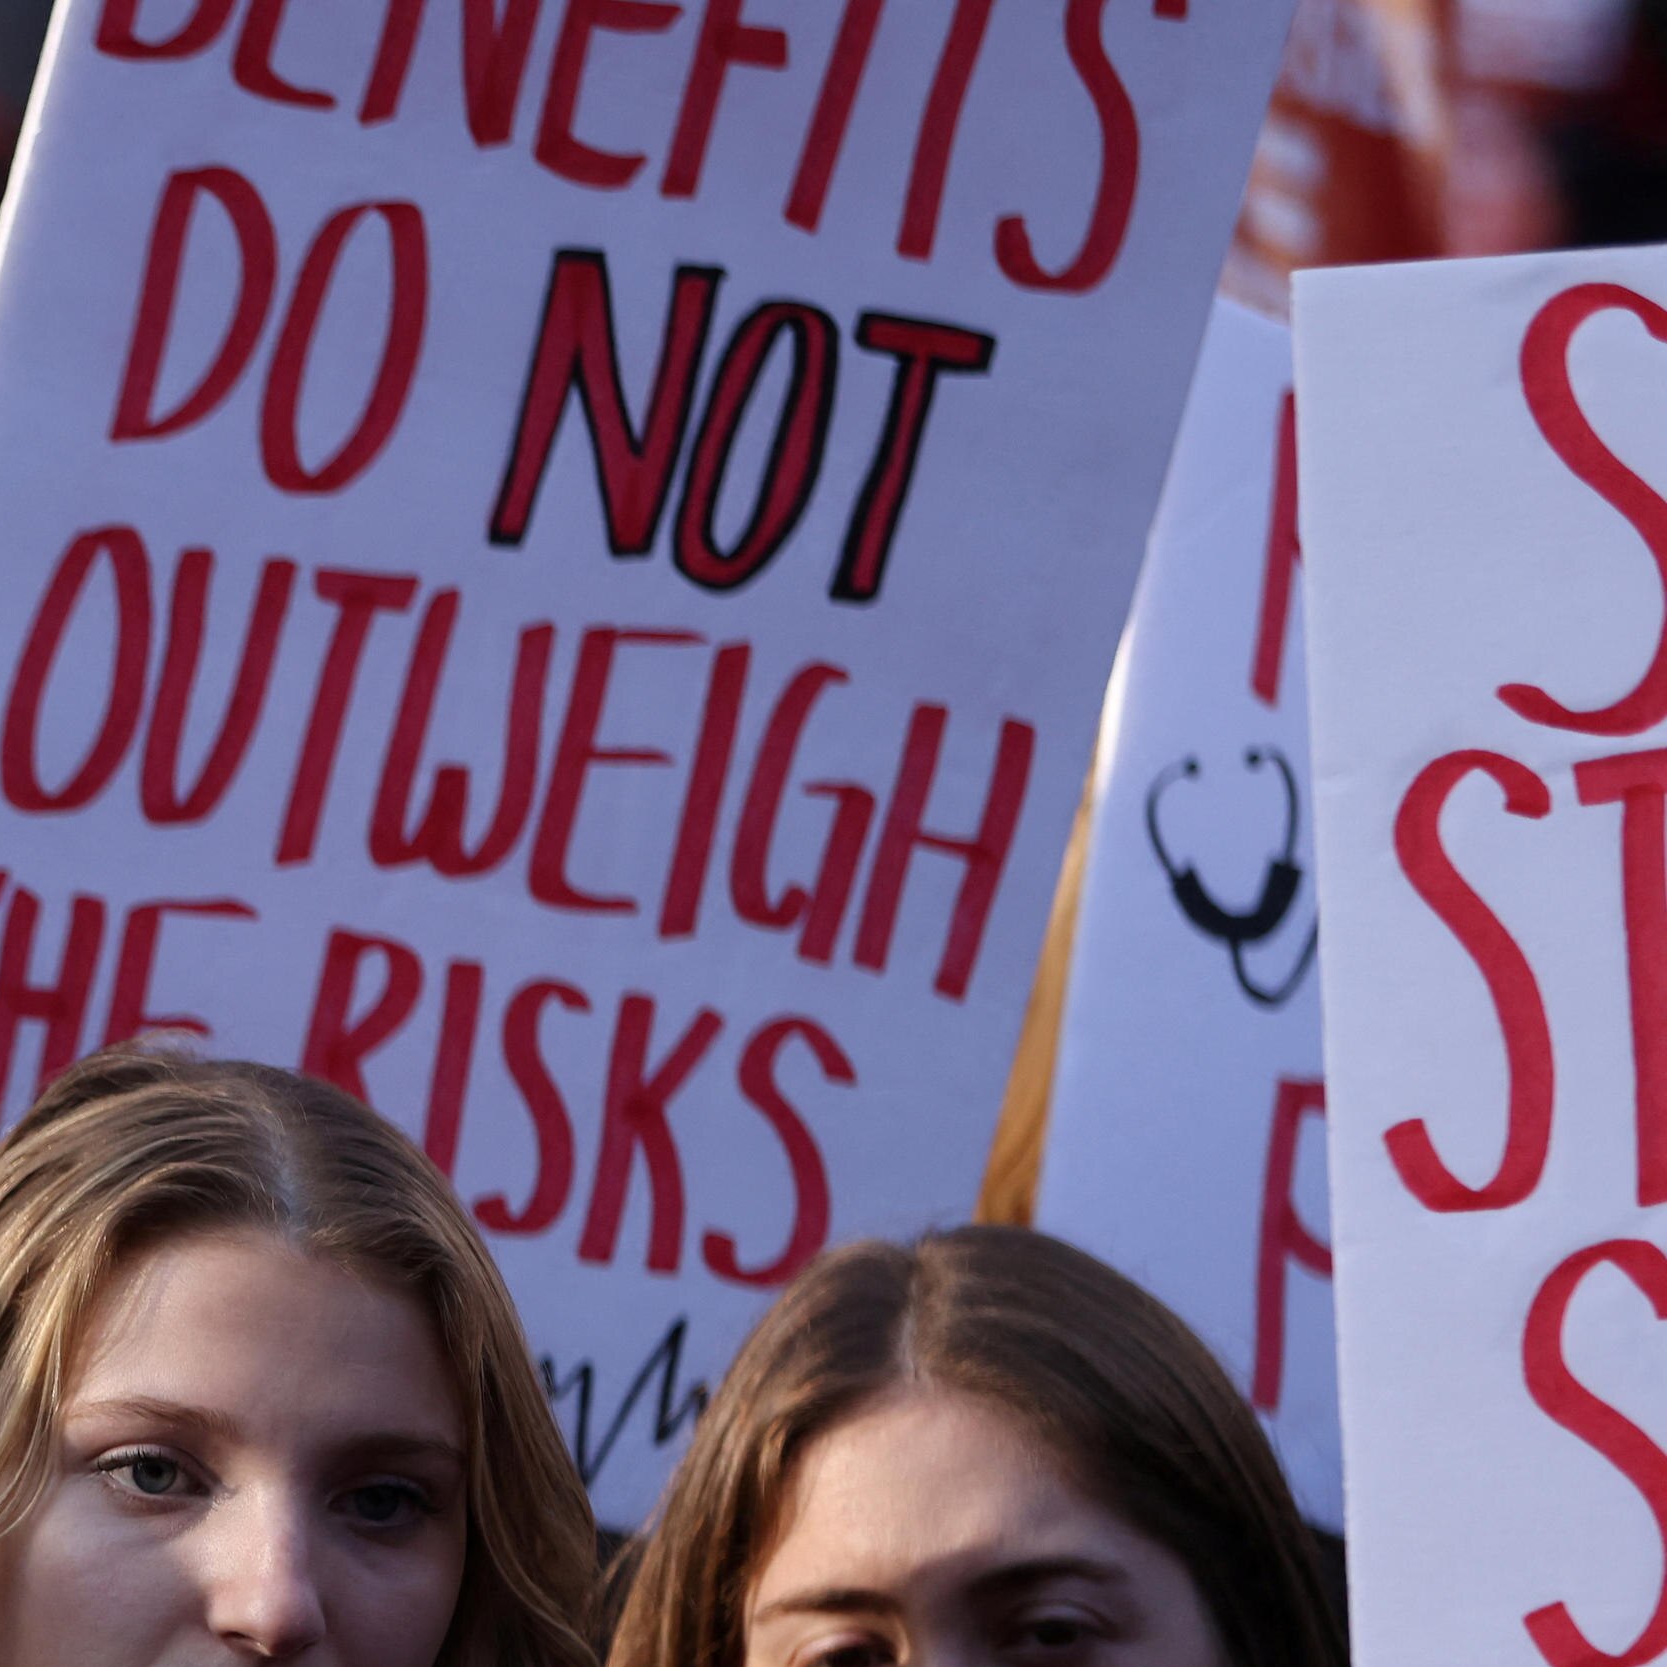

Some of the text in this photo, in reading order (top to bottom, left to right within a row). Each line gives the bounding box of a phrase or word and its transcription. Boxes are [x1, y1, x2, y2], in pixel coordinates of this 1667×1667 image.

[95, 0, 1187, 294] NEFITS
[110, 165, 427, 495] DO
[488, 247, 997, 603] NOT
[302, 927, 857, 1289] RISKS
